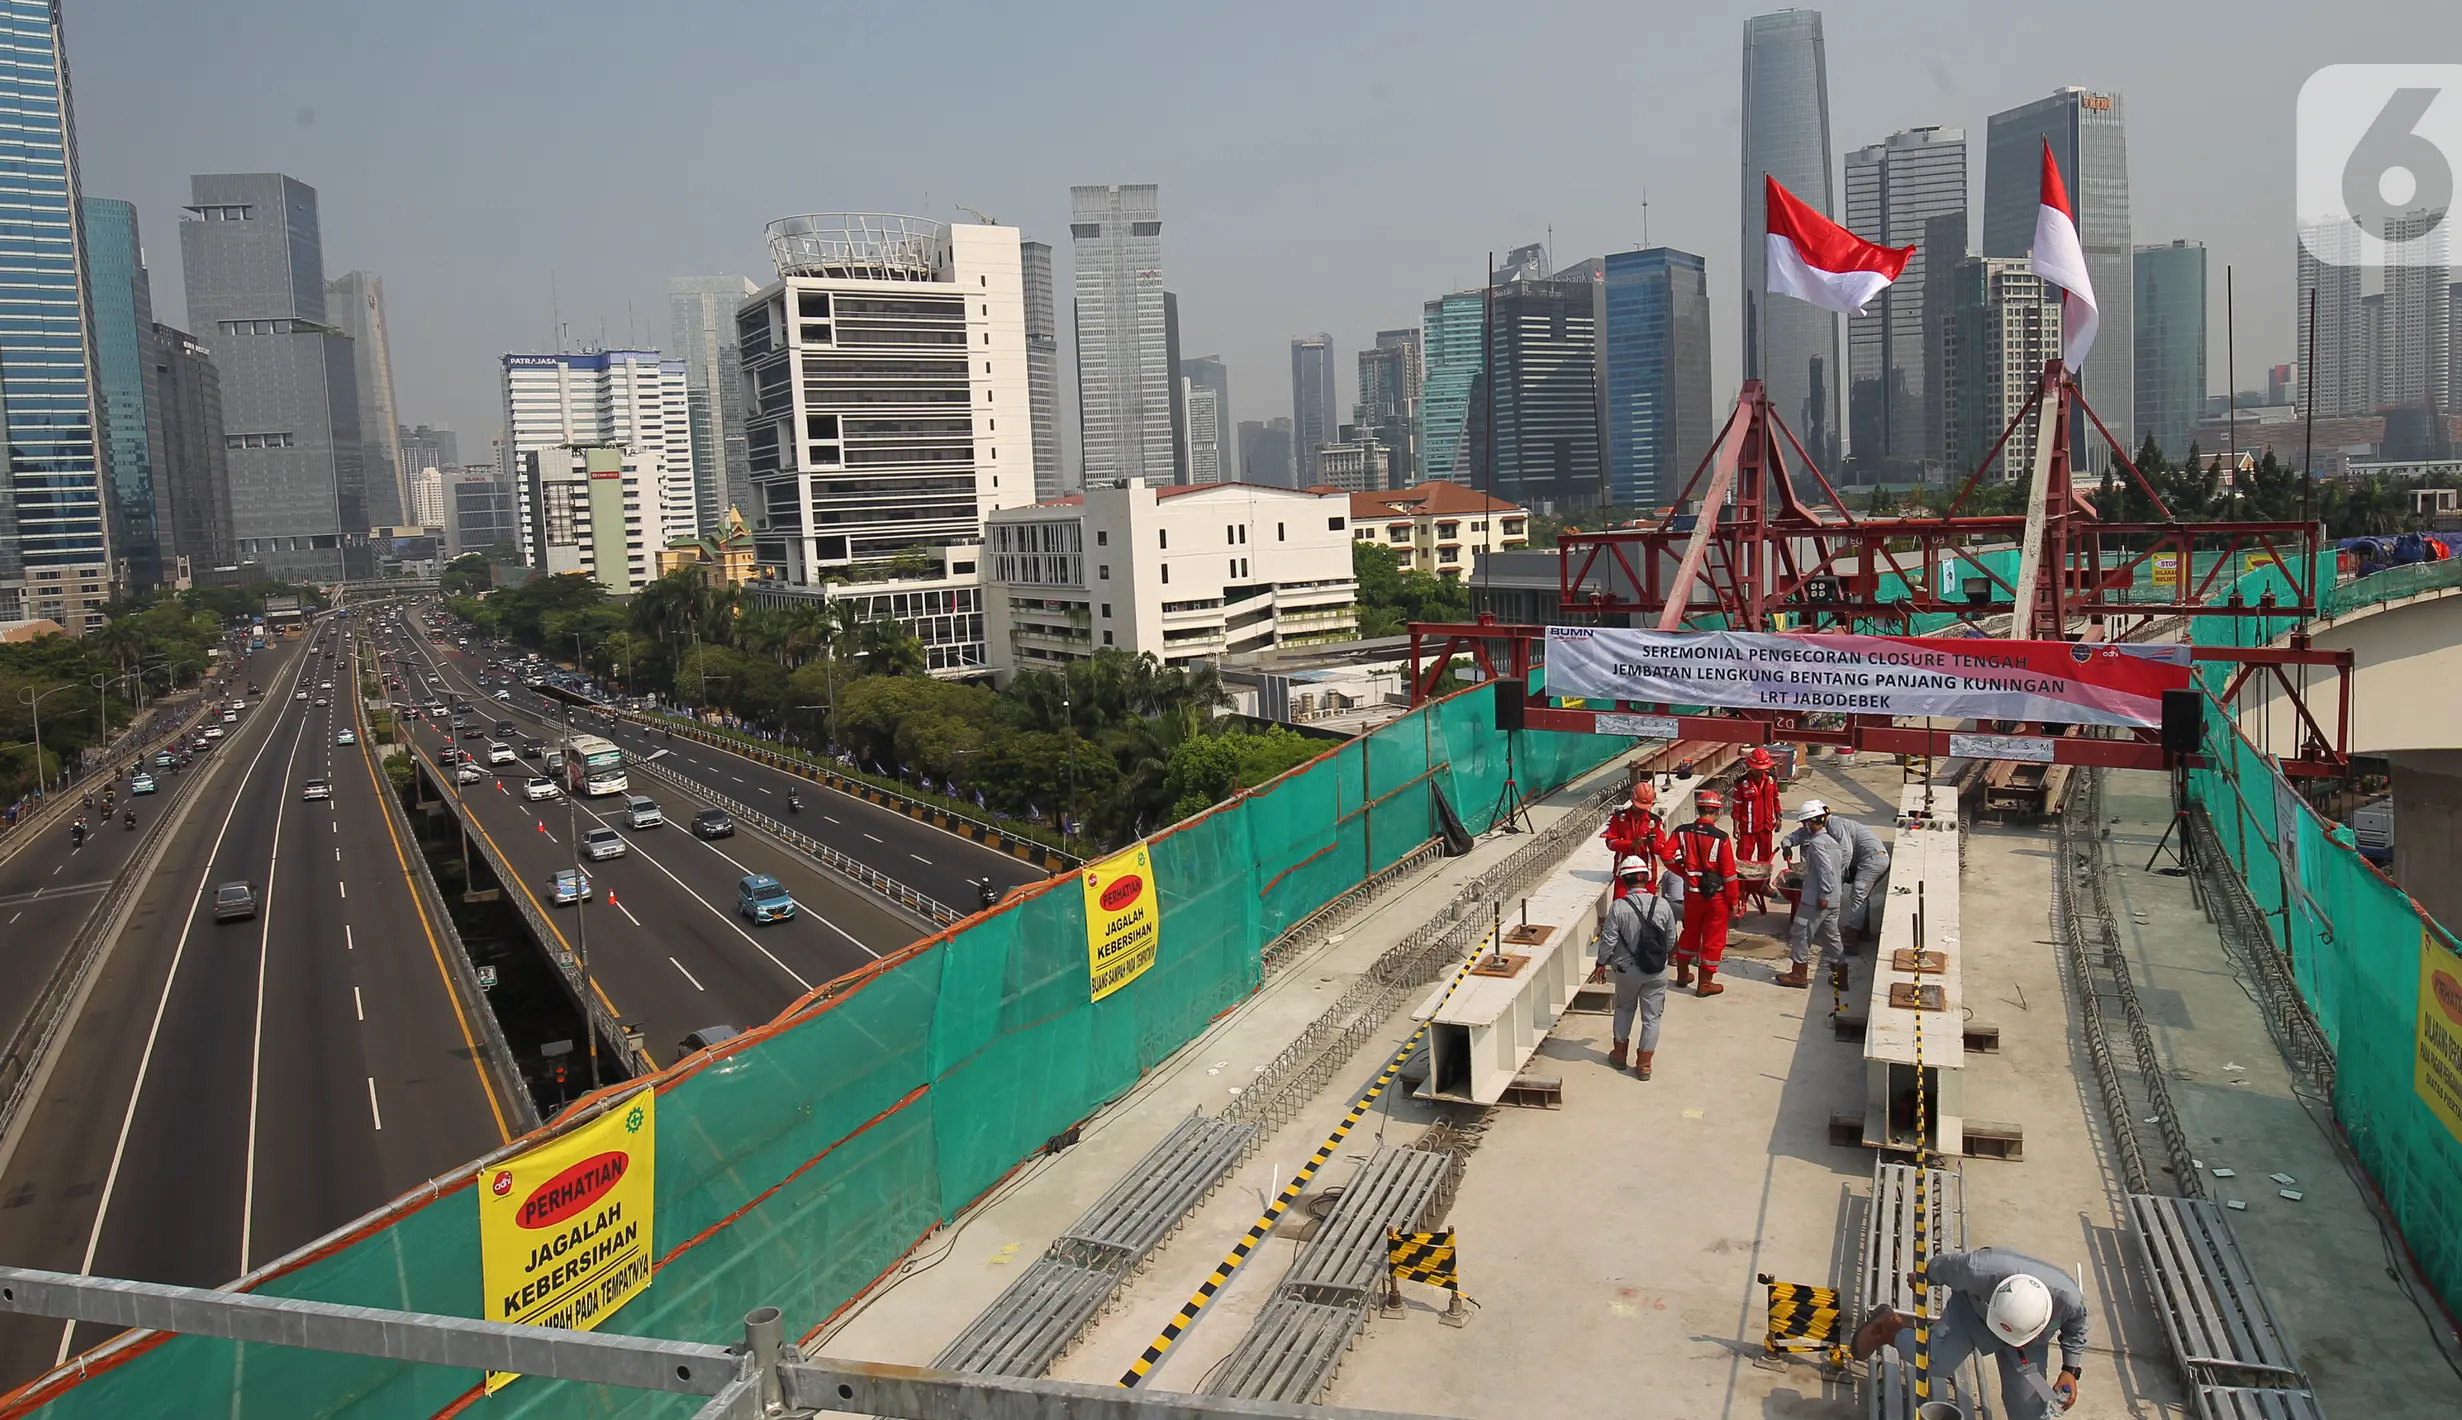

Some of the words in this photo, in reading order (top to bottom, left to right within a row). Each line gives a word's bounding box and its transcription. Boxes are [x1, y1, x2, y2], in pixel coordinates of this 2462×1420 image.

[1551, 628, 1594, 637] BUMN
[1643, 645, 1743, 660] SEREMONIAL
[1749, 648, 1862, 665] PENGECORAN
[1868, 652, 1946, 667] CLOSURE
[1952, 654, 2029, 670] TENGAH
[1612, 663, 1692, 679] JEMBATAN
[1697, 666, 1784, 683] LENGKUNG
[1790, 671, 1869, 687] BENTANG
[1875, 673, 1957, 690] PANJANG
[1963, 676, 2065, 693] KUNINGAN
[1760, 691, 1788, 704] LRT
[1793, 692, 1890, 708] JABODEBEK
[1103, 878, 1141, 907] PERHATIAN
[1105, 907, 1144, 937] JAGALAH
[1097, 922, 1152, 960] KEBERSIHAN
[494, 1175, 511, 1191] adhi
[525, 1156, 622, 1225] PERHATIAN
[525, 1202, 621, 1273] JAGALAH
[504, 1221, 637, 1317] KEBERSIHAN
[576, 1288, 599, 1325] PADA
[601, 1253, 648, 1307] TEMPATNYA
